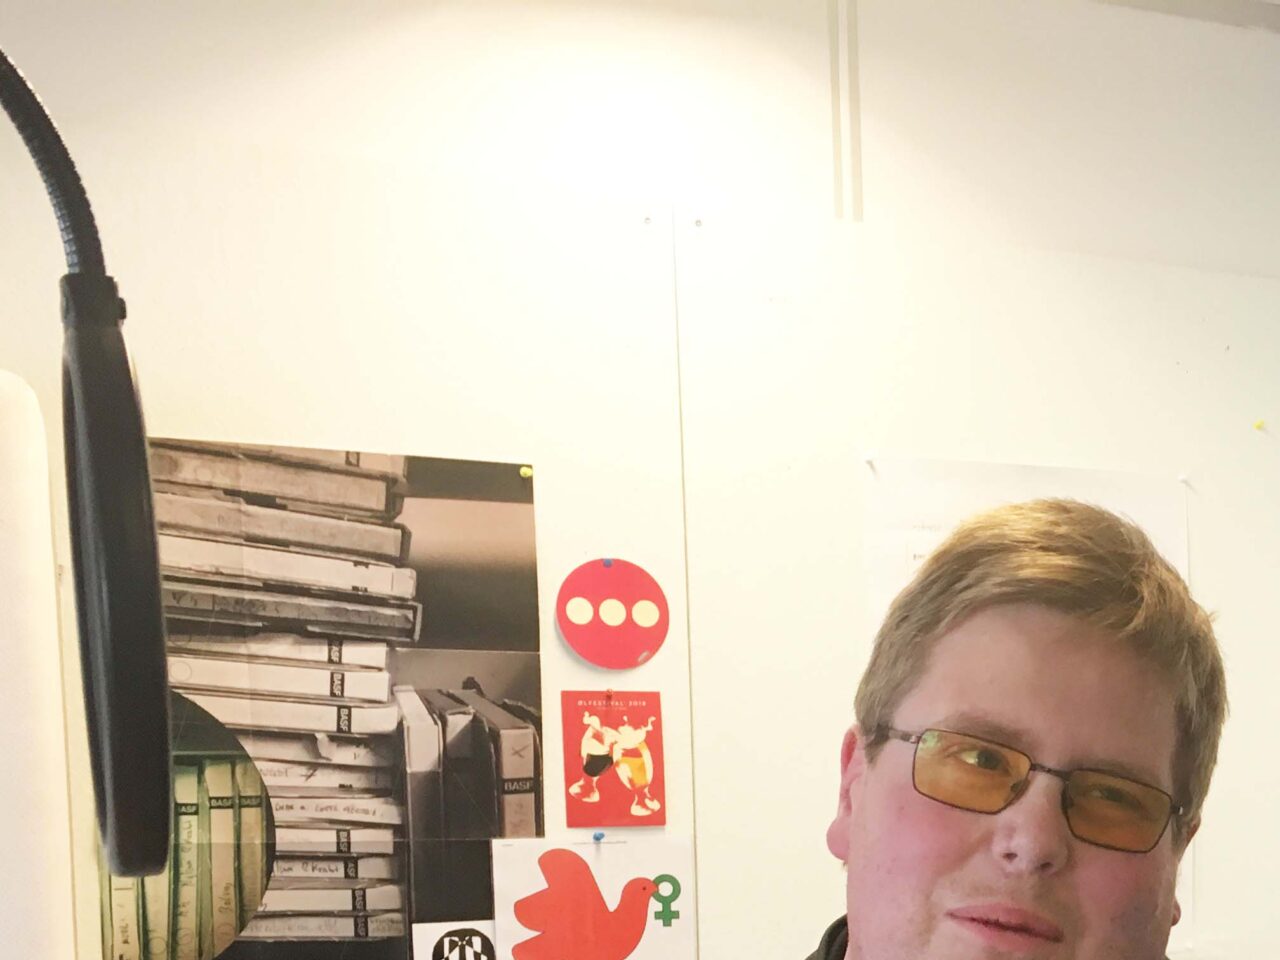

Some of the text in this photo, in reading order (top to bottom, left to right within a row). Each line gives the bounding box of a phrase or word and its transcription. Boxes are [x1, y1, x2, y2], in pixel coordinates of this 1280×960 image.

[332, 673, 342, 697] BASF
[340, 708, 349, 732] BASF
[504, 780, 532, 791] BASF
[339, 831, 348, 853] BASF
[354, 889, 364, 911] BASF
